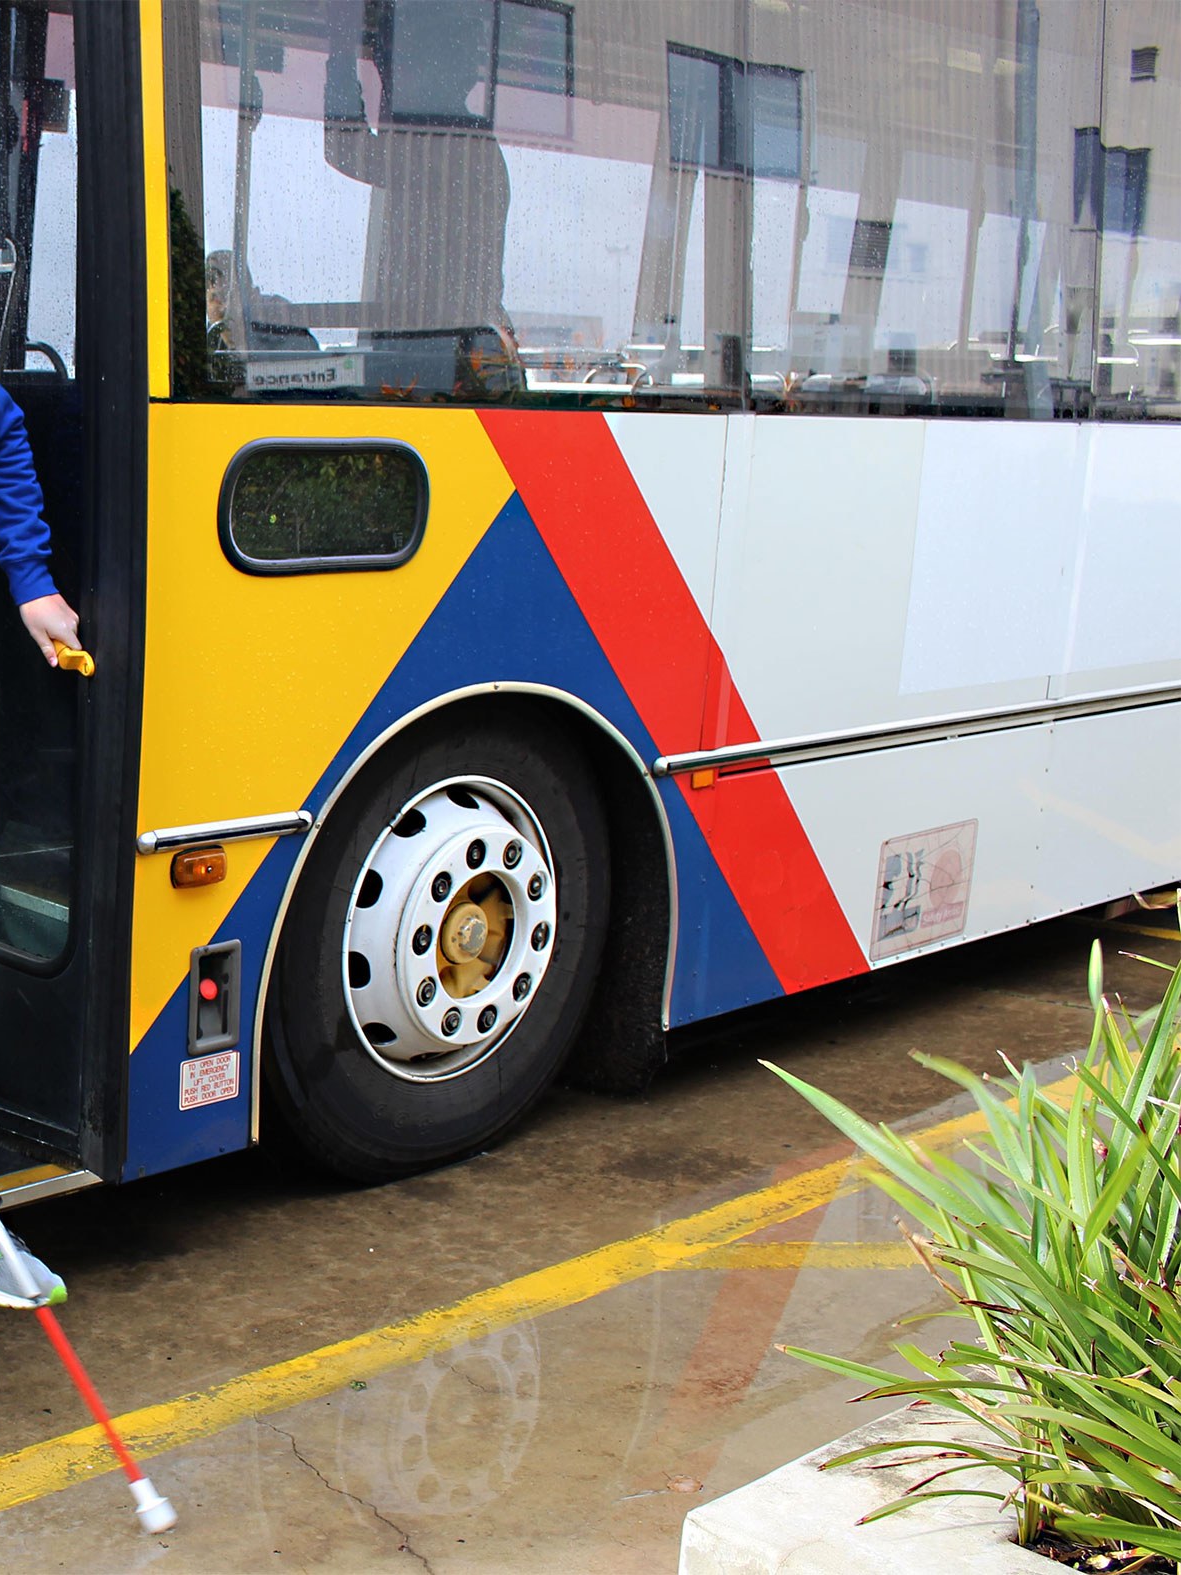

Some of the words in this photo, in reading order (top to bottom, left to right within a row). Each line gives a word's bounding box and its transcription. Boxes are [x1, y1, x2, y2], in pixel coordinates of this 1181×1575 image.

[216, 1055, 231, 1064] DOOR
[184, 1087, 198, 1096] PUSH
[213, 1078, 234, 1089] BUTTON
[184, 1095, 198, 1104] PUSH
